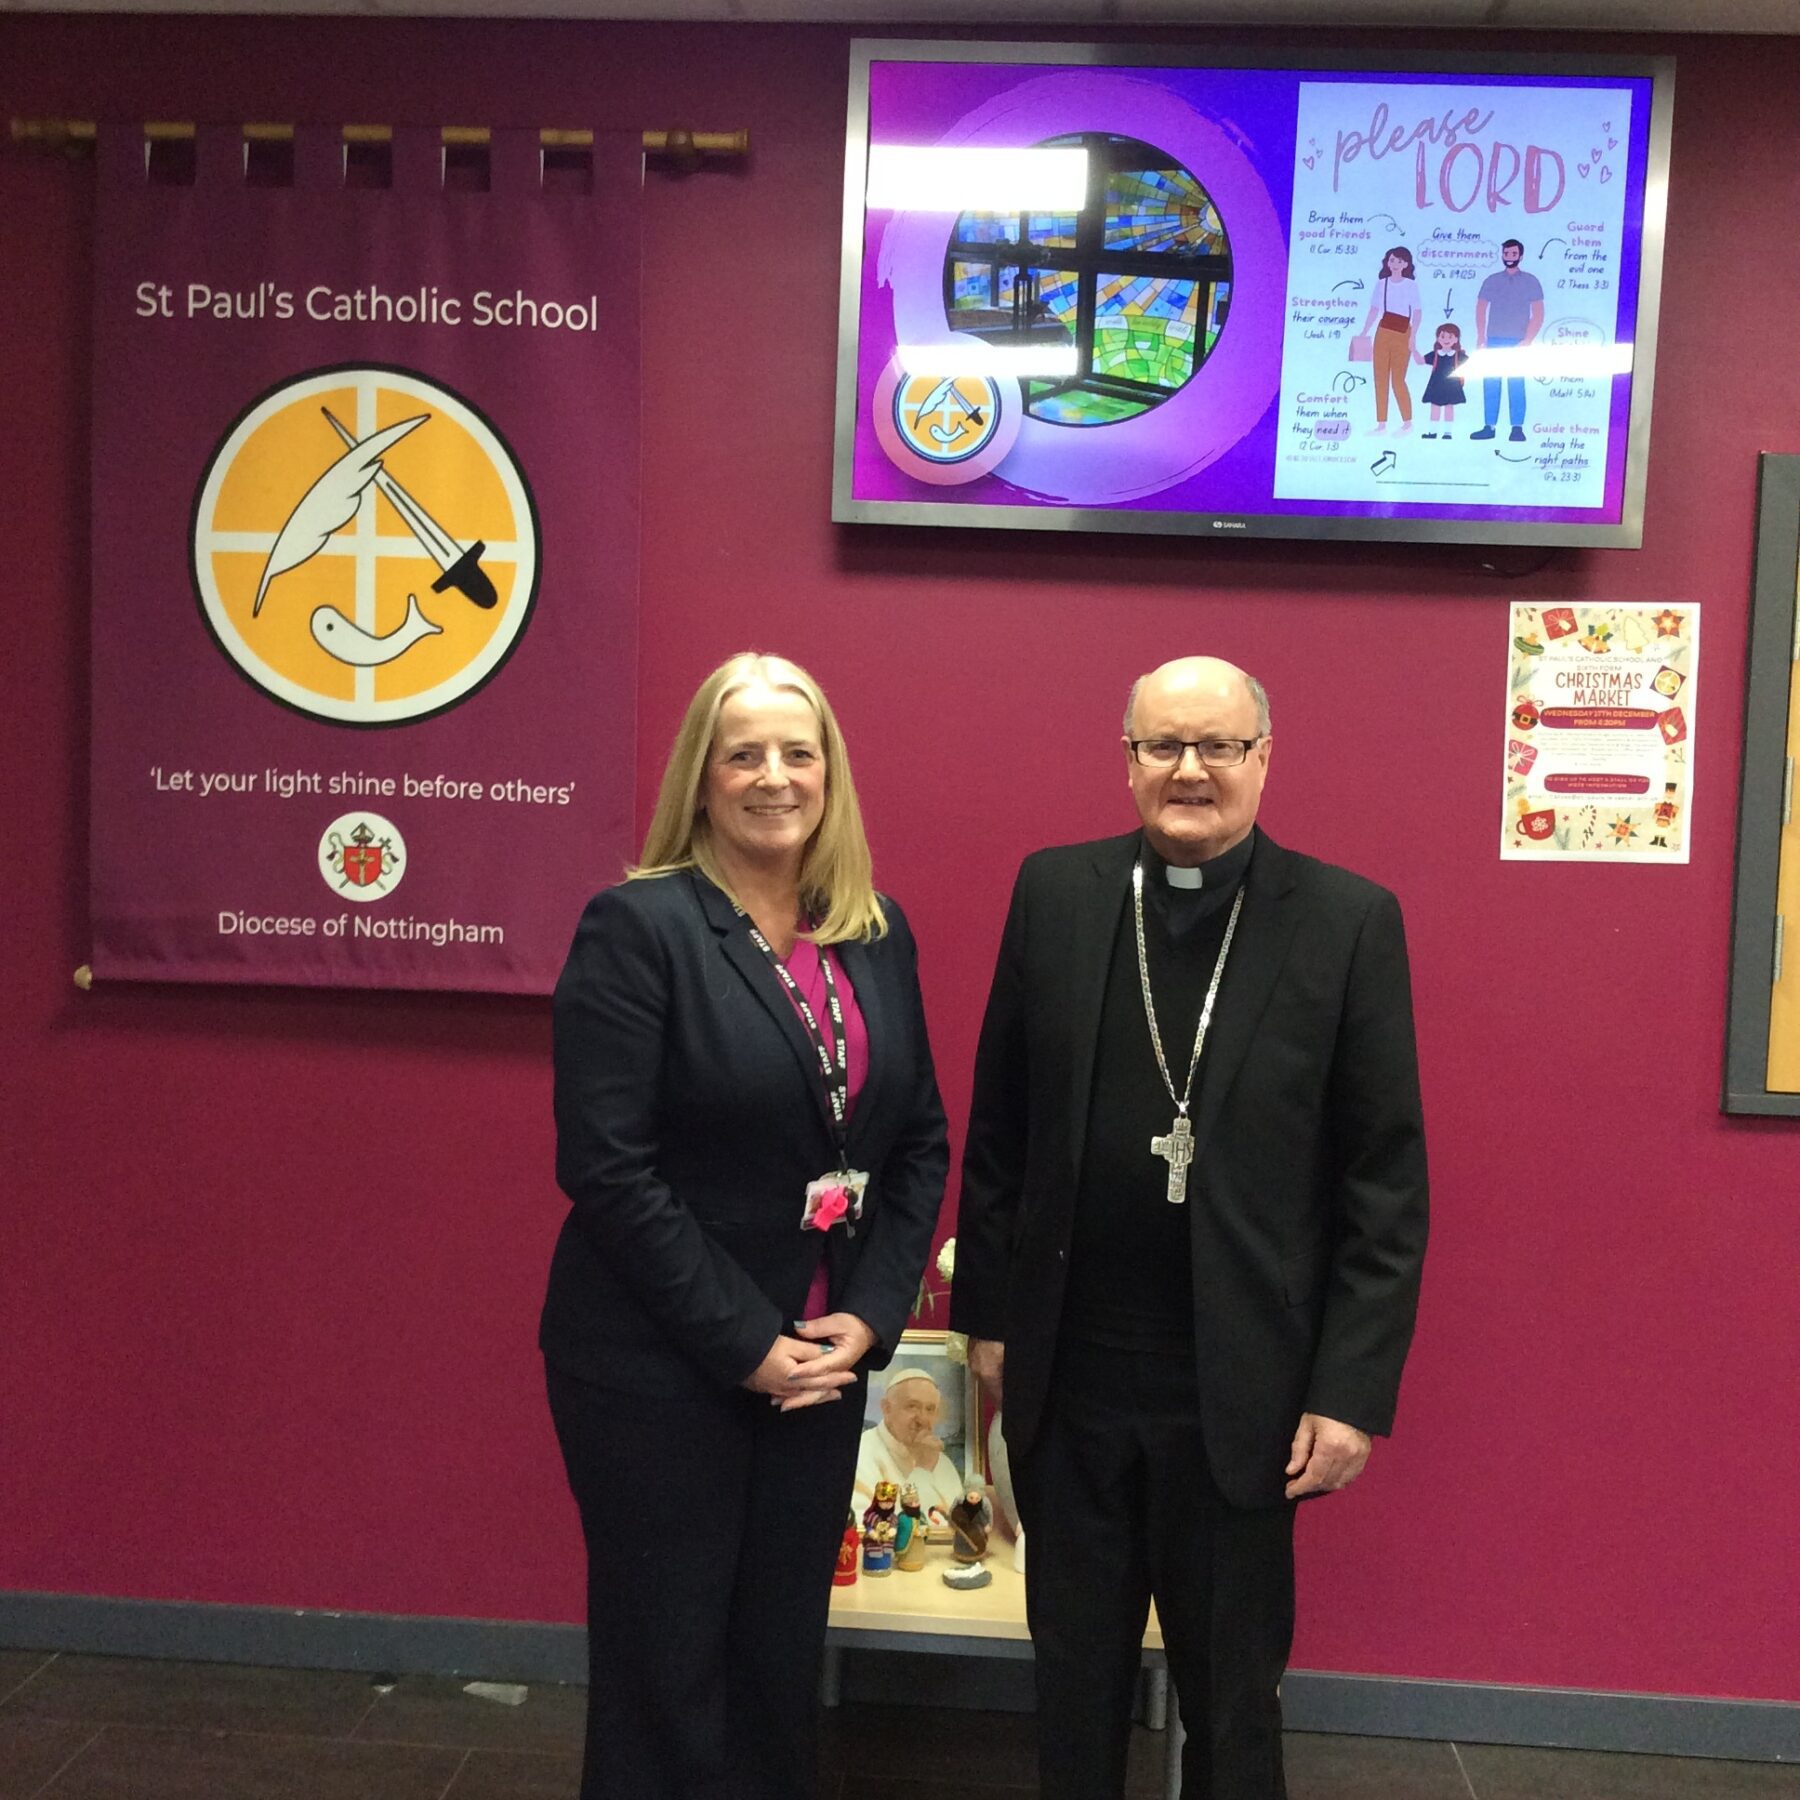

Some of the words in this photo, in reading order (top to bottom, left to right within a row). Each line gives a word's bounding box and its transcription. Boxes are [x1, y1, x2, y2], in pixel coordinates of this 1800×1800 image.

[1333, 102, 1495, 192] please
[1415, 141, 1566, 213] LORD
[1308, 210, 1335, 228] Bring
[1339, 211, 1364, 223] them
[1567, 221, 1605, 232] Guard
[1299, 228, 1326, 241] good
[1329, 228, 1371, 239] friends
[1432, 227, 1453, 239] Give
[1457, 228, 1481, 240] them
[1571, 236, 1602, 247] them
[1421, 247, 1494, 259] discernment
[1564, 248, 1588, 260] from
[1592, 249, 1608, 261] the
[136, 282, 174, 318] St
[188, 282, 295, 319] Paul’s
[306, 285, 462, 326] Catholic
[472, 289, 598, 332] School
[1292, 296, 1358, 310] Strengthen
[1292, 311, 1315, 322] their
[1318, 316, 1356, 328] courage
[1558, 327, 1589, 338] Shine
[1296, 392, 1349, 404] Comfort
[1296, 406, 1320, 417] them
[1323, 407, 1348, 418] when
[1292, 422, 1314, 439] they
[1317, 423, 1340, 434] need
[1342, 422, 1350, 435] it
[1533, 422, 1566, 433] Guide
[1570, 424, 1600, 434] them
[1540, 437, 1566, 454] along
[1570, 438, 1585, 449] the
[1534, 453, 1559, 470] right
[1560, 454, 1589, 469] paths
[1555, 672, 1643, 689] CHRISTMAS
[1573, 688, 1631, 707] MARKET
[1544, 709, 1593, 718] WEDNESDAY
[1613, 710, 1656, 718] DECEMBER
[199, 773, 258, 797] your
[265, 768, 322, 798] light
[328, 771, 396, 797] shine
[403, 772, 484, 800] before
[489, 778, 576, 805] others’
[218, 910, 317, 936] Diocese
[322, 913, 349, 937] of
[354, 915, 504, 947] Nottingham
[774, 964, 796, 989] STAFF
[799, 1001, 817, 1030] STAFF
[830, 996, 843, 1024] STAFF
[817, 1045, 833, 1076] STAFF
[836, 1038, 846, 1070] STAFF
[830, 1091, 844, 1122] STAFF
